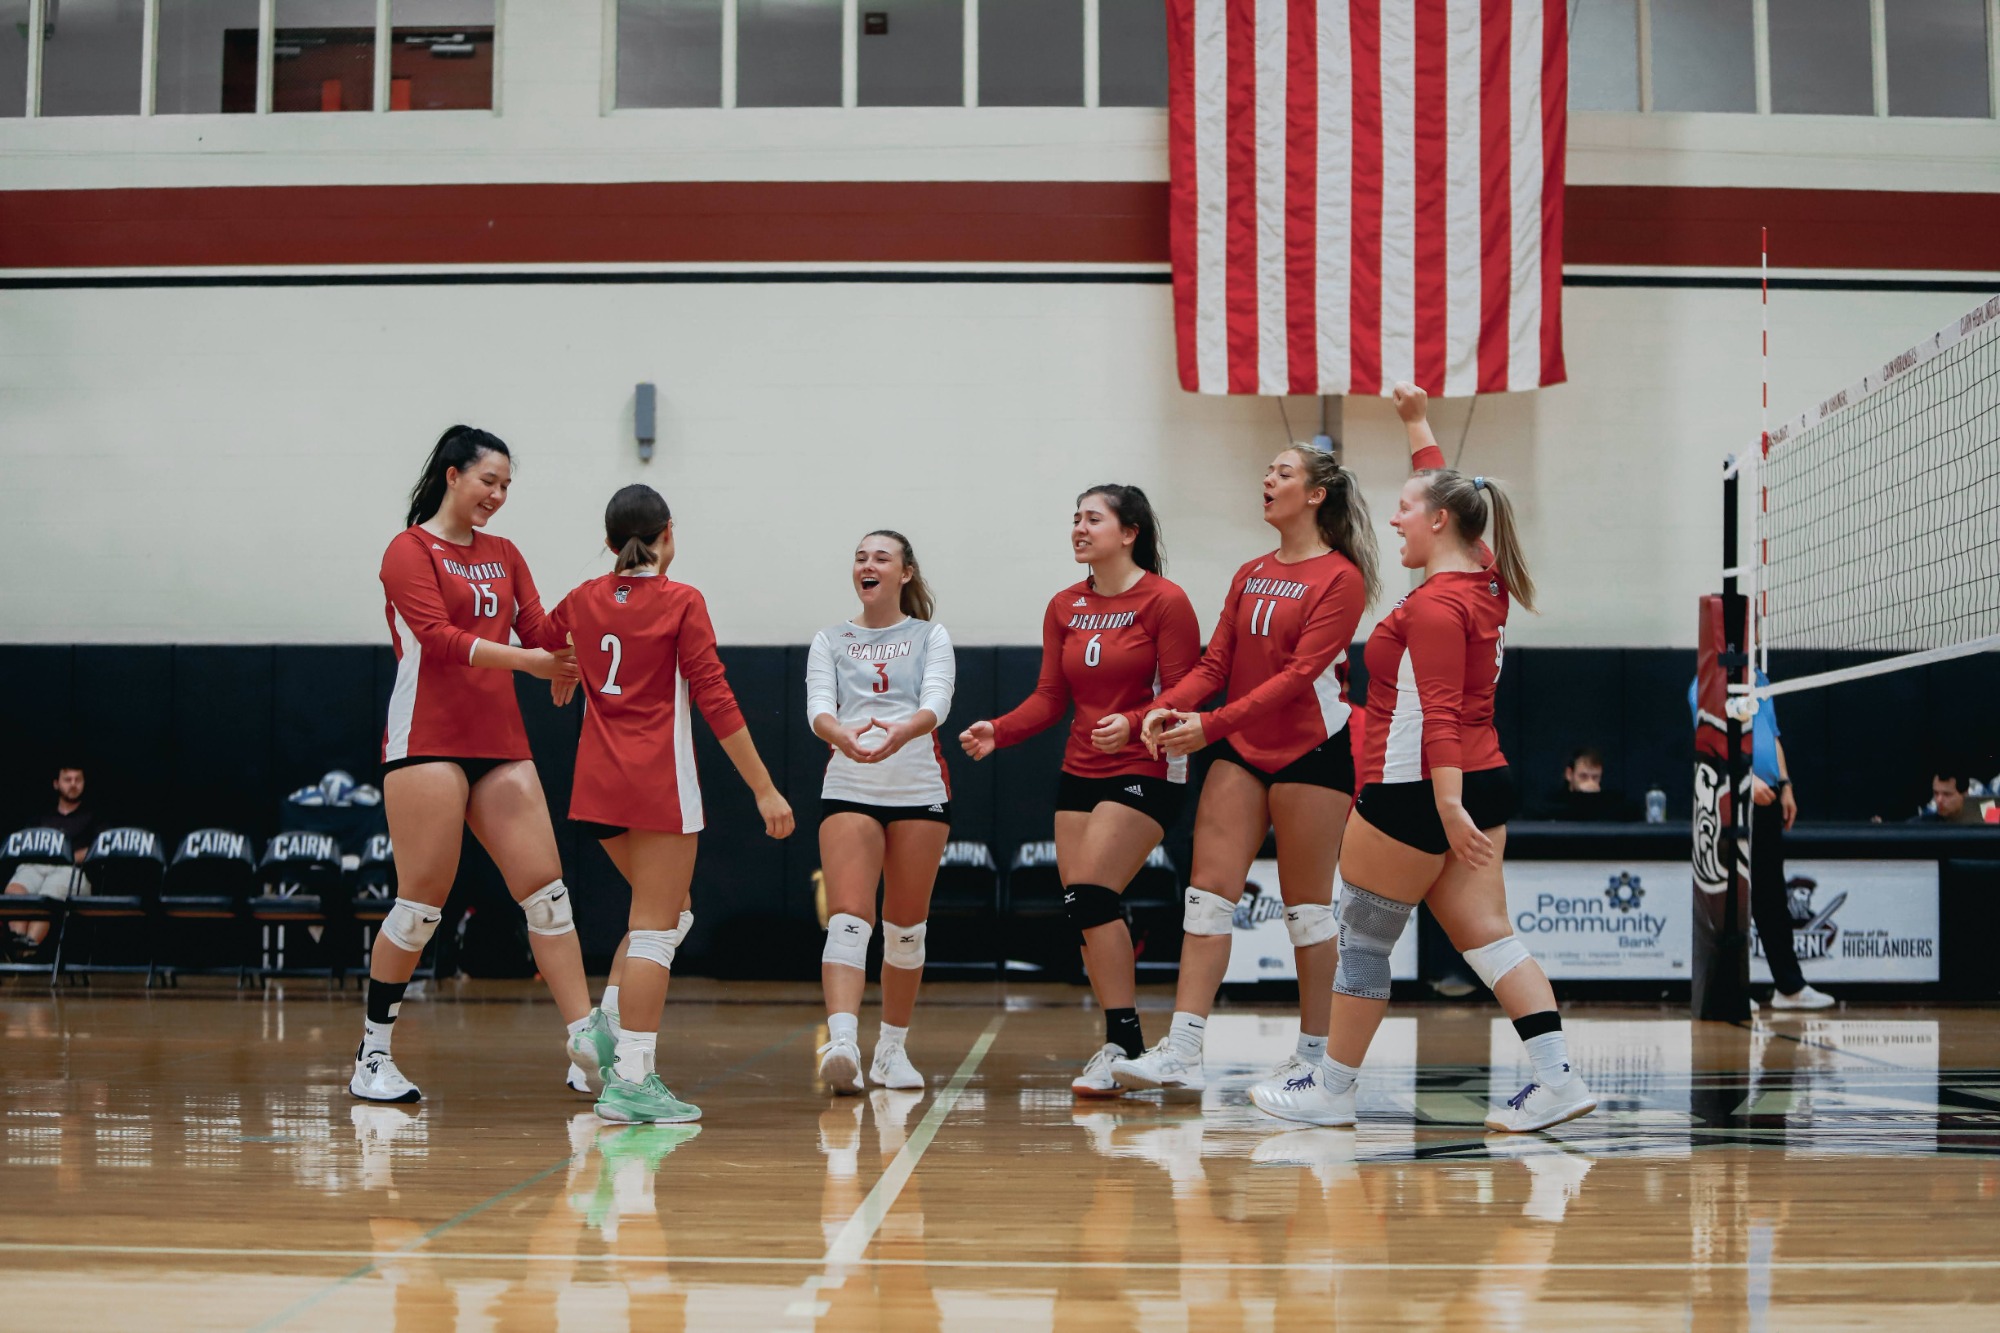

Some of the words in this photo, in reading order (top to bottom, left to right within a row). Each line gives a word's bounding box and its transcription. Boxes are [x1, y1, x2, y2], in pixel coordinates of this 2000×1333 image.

[468, 582, 499, 618] 15
[1243, 576, 1310, 600] HIGHLANDERS
[1067, 610, 1138, 630] HIGHLANDERS
[1250, 598, 1278, 637] 11
[847, 641, 912, 661] CAIRN
[1084, 633, 1103, 668] 6
[599, 632, 622, 696] 2
[872, 662, 889, 693] 3
[8, 831, 65, 857] CAIRN
[97, 831, 155, 857] CAIRN
[186, 832, 244, 859] CAIRN
[274, 834, 333, 860] CAIRN
[1537, 894, 1604, 914] Penn
[1517, 912, 1667, 937] Community
[1619, 936, 1655, 948] Bank
[1842, 939, 1932, 958] HIGHLANDERS
